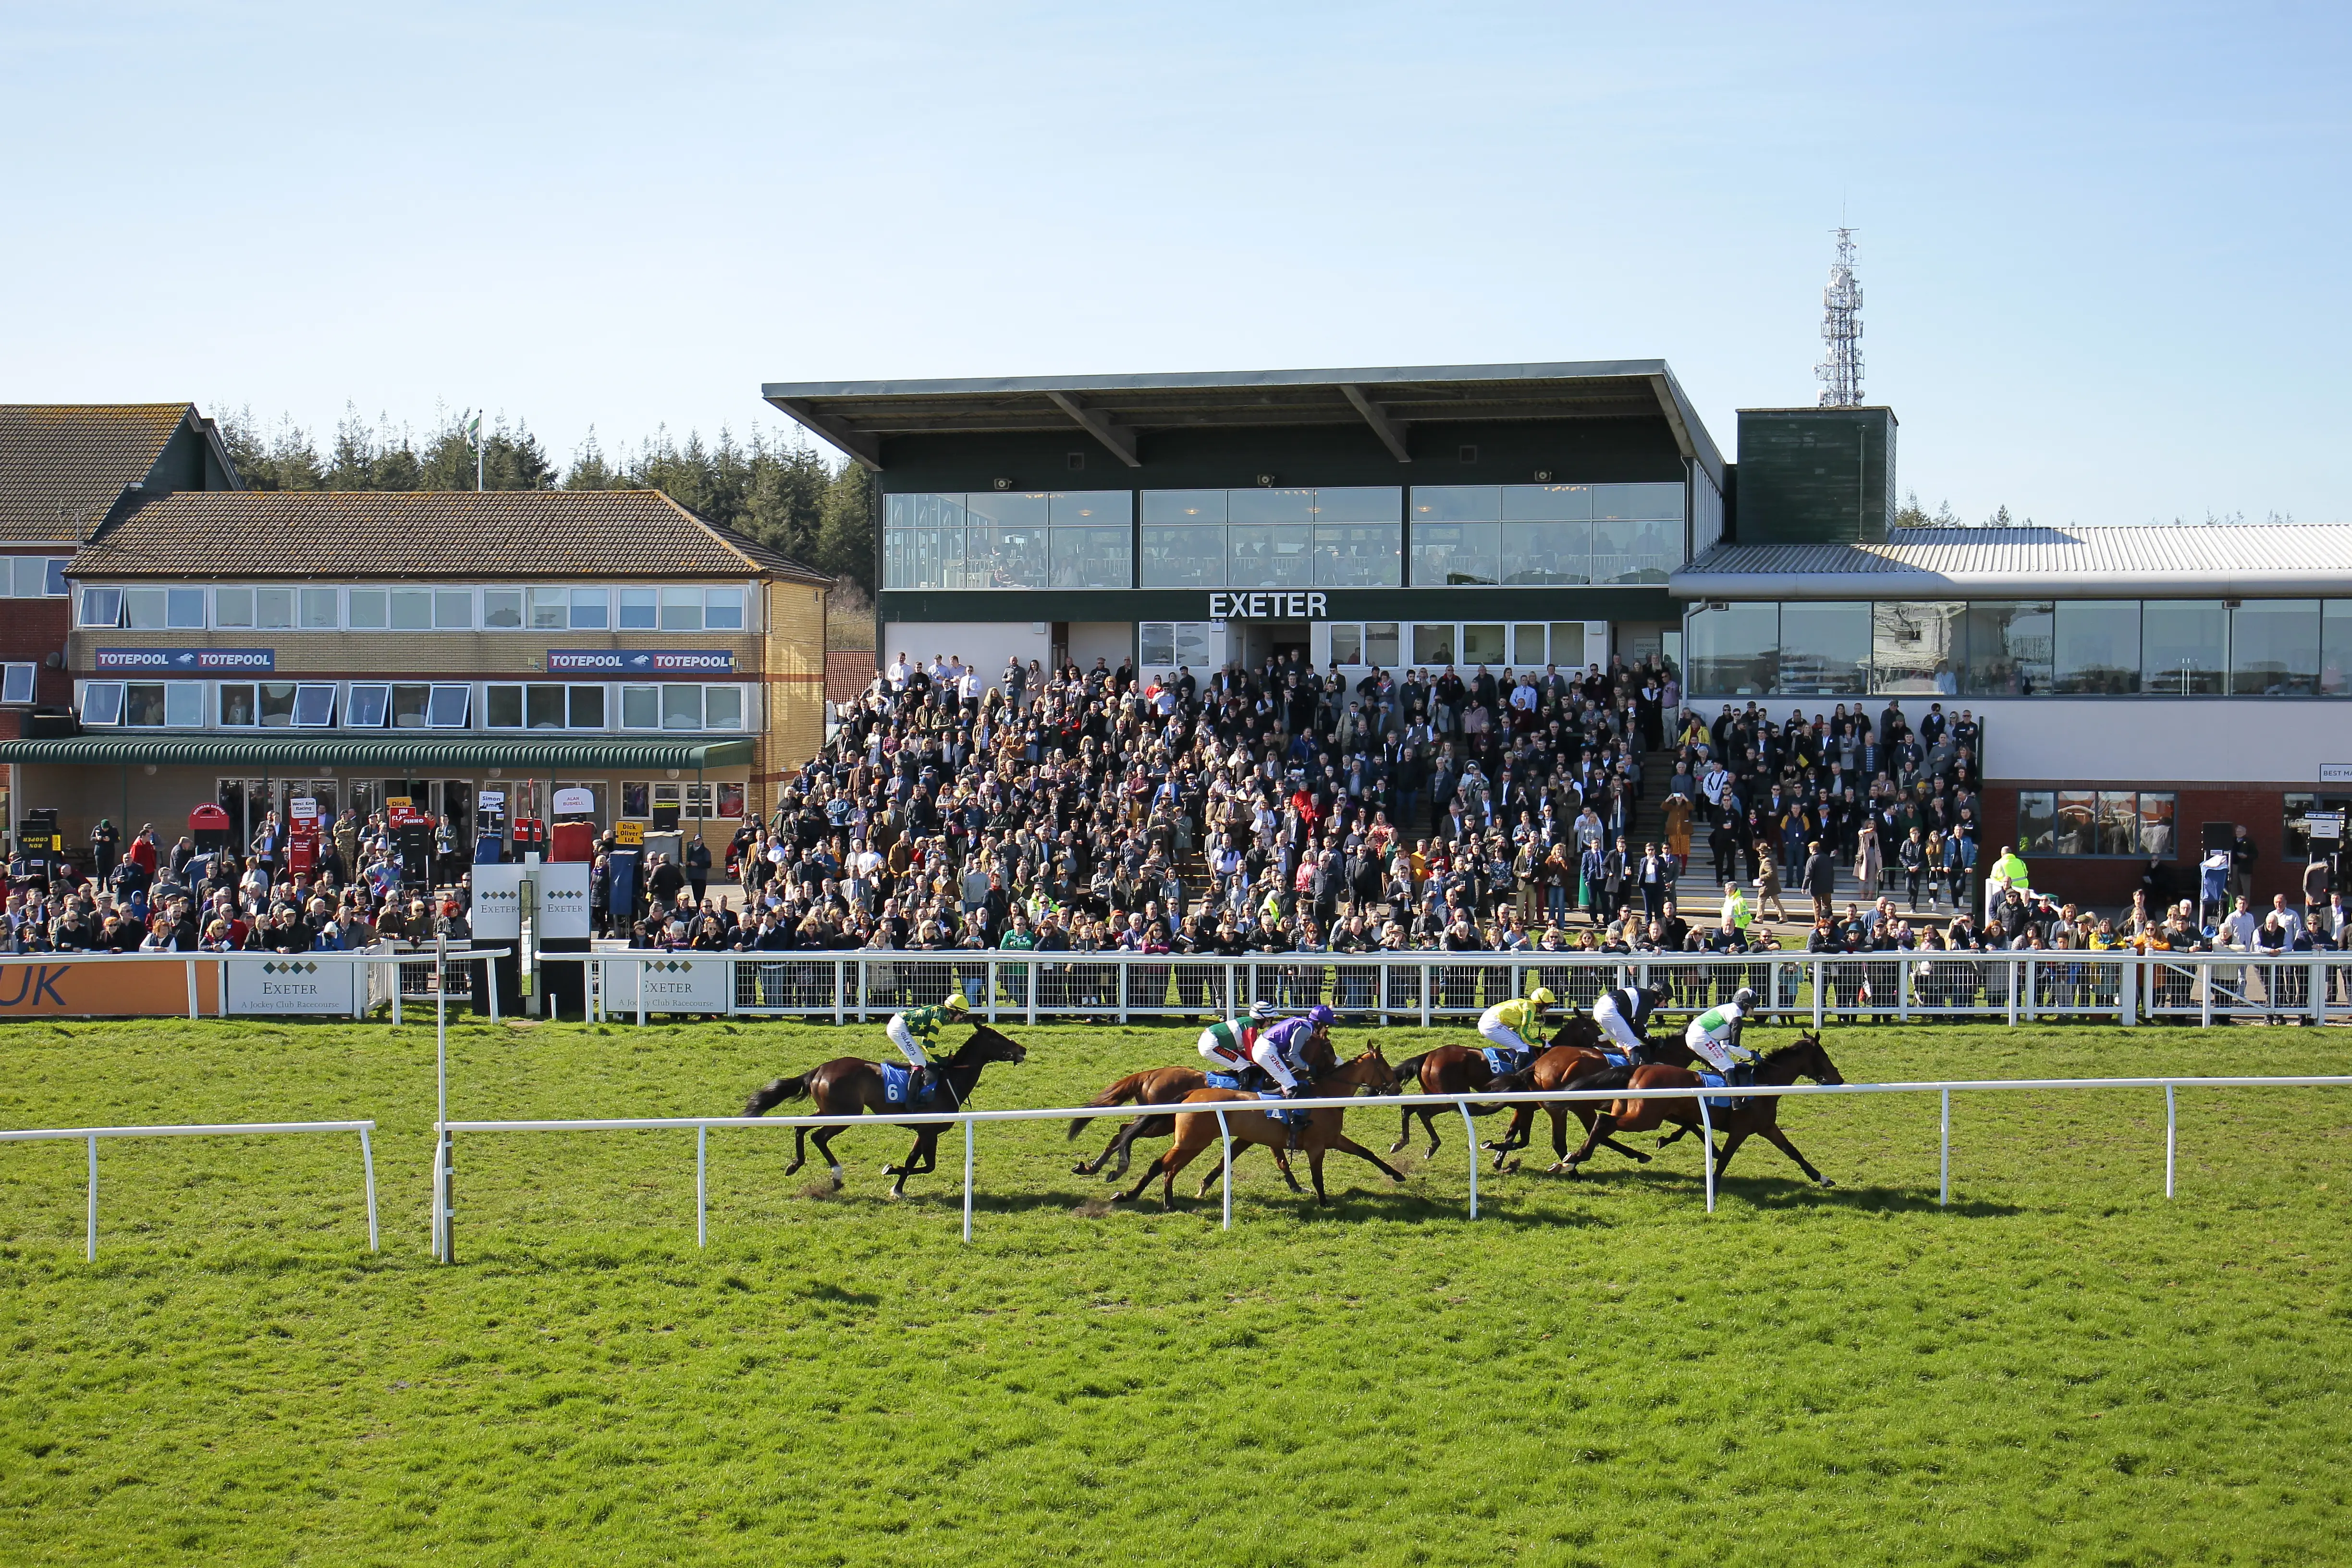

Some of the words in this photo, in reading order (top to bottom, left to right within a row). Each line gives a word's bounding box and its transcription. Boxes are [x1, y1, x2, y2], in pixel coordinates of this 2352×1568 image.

[1209, 592, 1327, 617] EXETER
[99, 653, 169, 665] TOTEPOOL
[200, 654, 271, 665] TOTEPOOL
[551, 655, 624, 667] TOTEPOOL
[656, 655, 729, 667] TOTEPOOL
[193, 804, 210, 816] NORMAN
[210, 804, 225, 815] BARNES
[481, 904, 517, 913] EXETER
[547, 904, 584, 913] EXETER
[0, 965, 72, 1006] UK
[263, 981, 318, 994] EXETER
[250, 1001, 274, 1010] Jockey
[627, 999, 650, 1007] Jocy
[901, 1031, 917, 1056] GILLARD'S
[887, 1084, 899, 1101] 6
